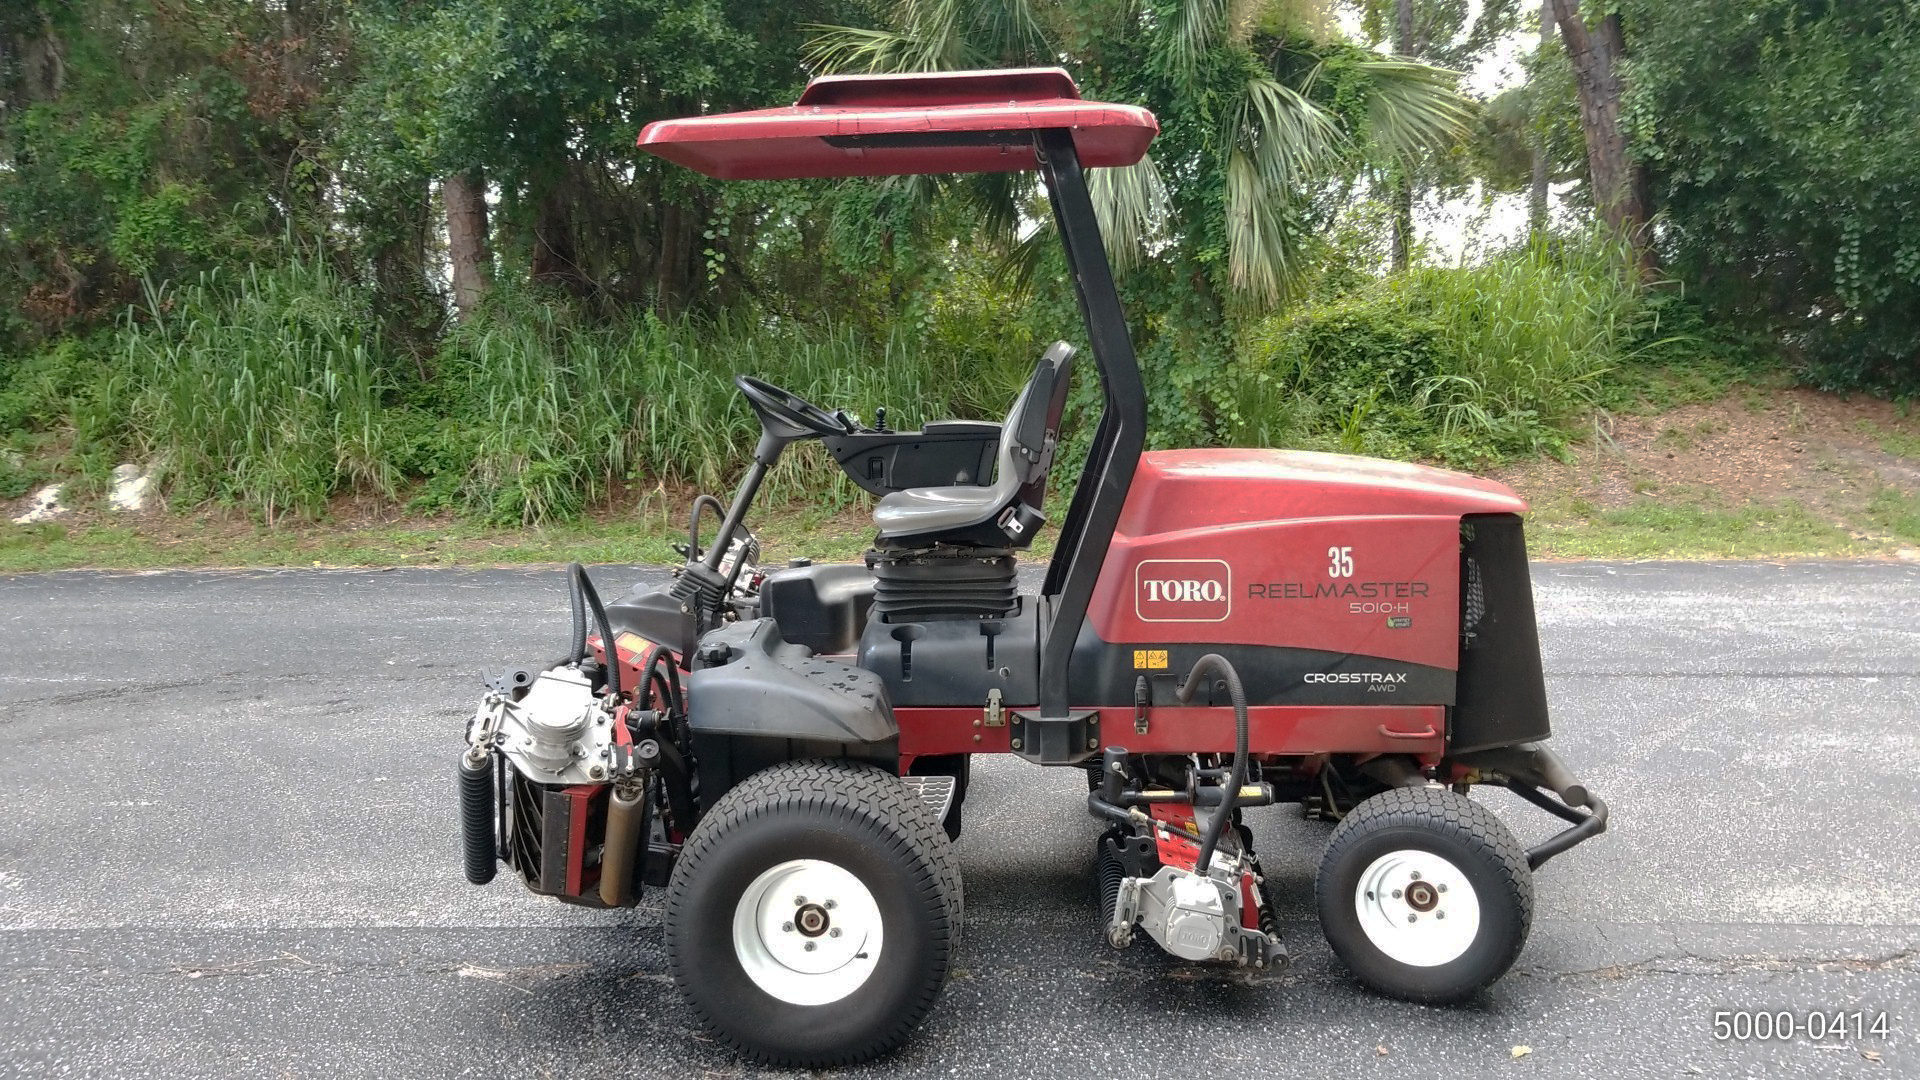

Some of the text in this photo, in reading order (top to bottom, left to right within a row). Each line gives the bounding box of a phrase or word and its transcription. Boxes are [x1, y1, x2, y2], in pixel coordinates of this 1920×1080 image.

[1328, 546, 1353, 578] 35
[1248, 582, 1429, 599] REELMASTER
[1303, 672, 1407, 684] CROSSTRAX
[1366, 684, 1396, 693] AWD
